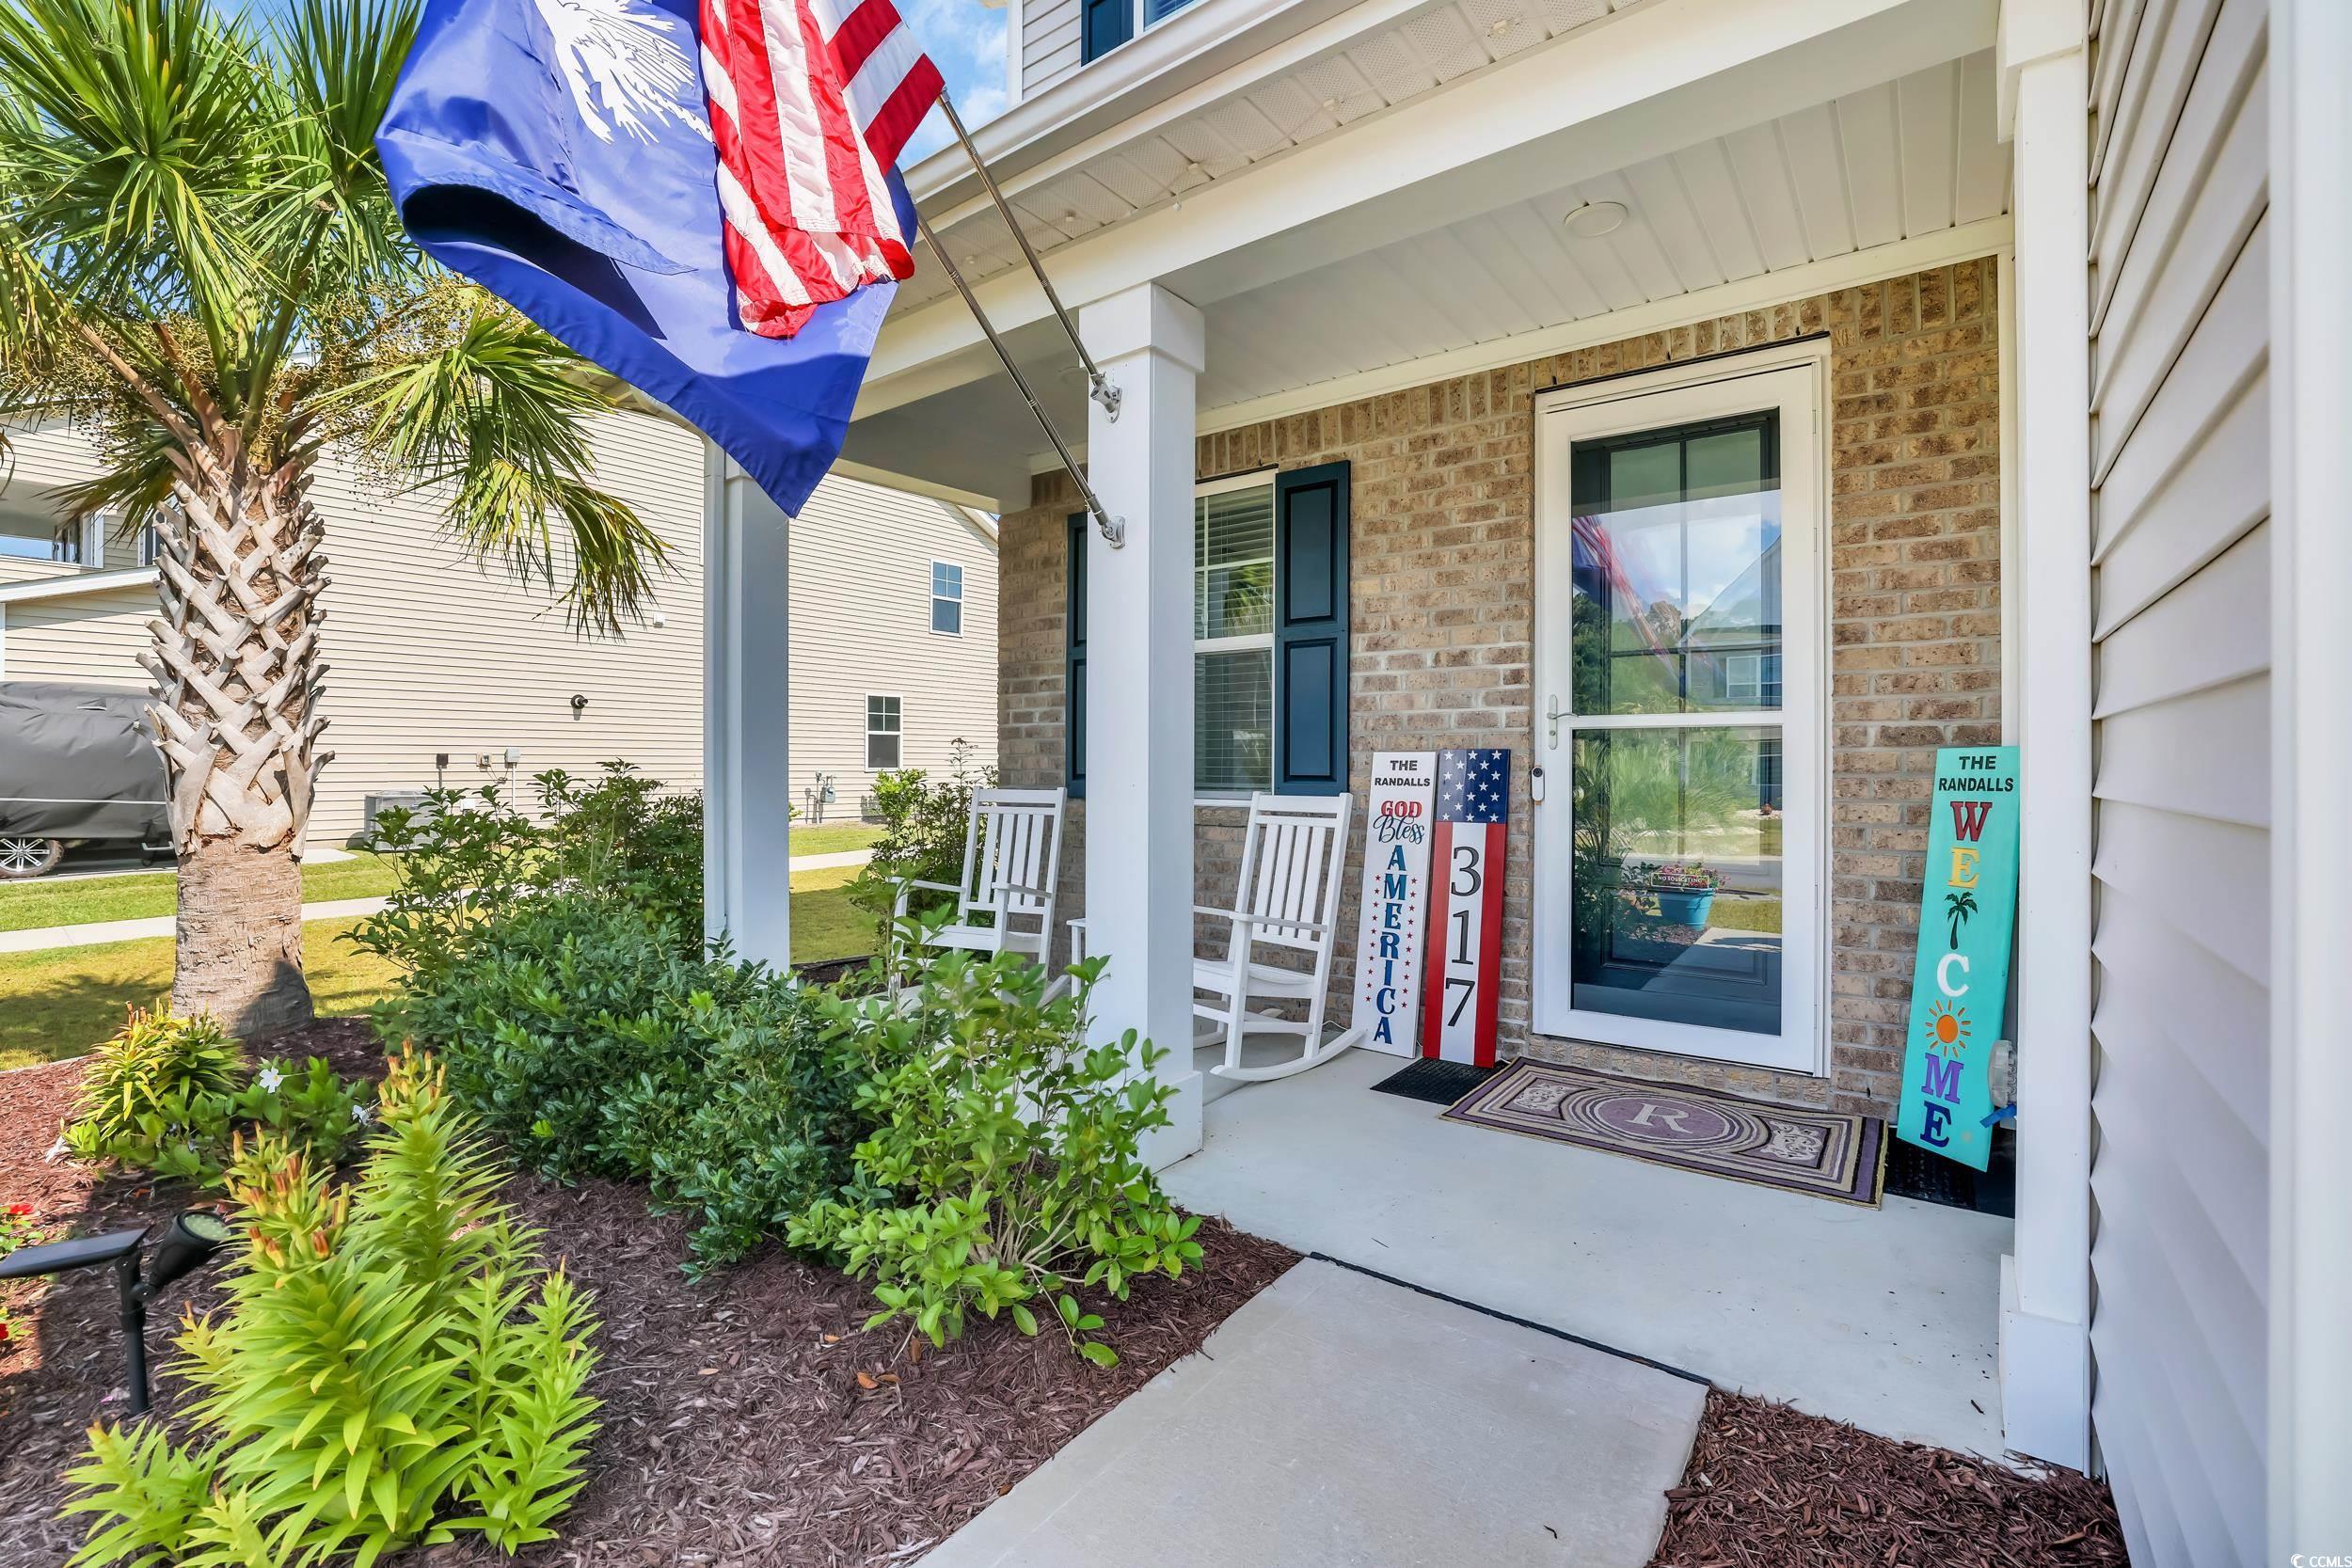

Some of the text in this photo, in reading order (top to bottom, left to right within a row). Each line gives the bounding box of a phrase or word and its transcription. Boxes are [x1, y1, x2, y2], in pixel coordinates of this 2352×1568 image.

[1390, 760, 1418, 771] THE
[1959, 755, 1997, 771] THE
[1375, 777, 1430, 787] RANDALLS
[1938, 777, 2014, 793] RANDALLS
[1381, 800, 1422, 818] GOD
[1373, 814, 1425, 845] Bless
[1373, 845, 1407, 1045] AMERICA
[1445, 846, 1482, 1027] 317
[1626, 1103, 1692, 1132] R
